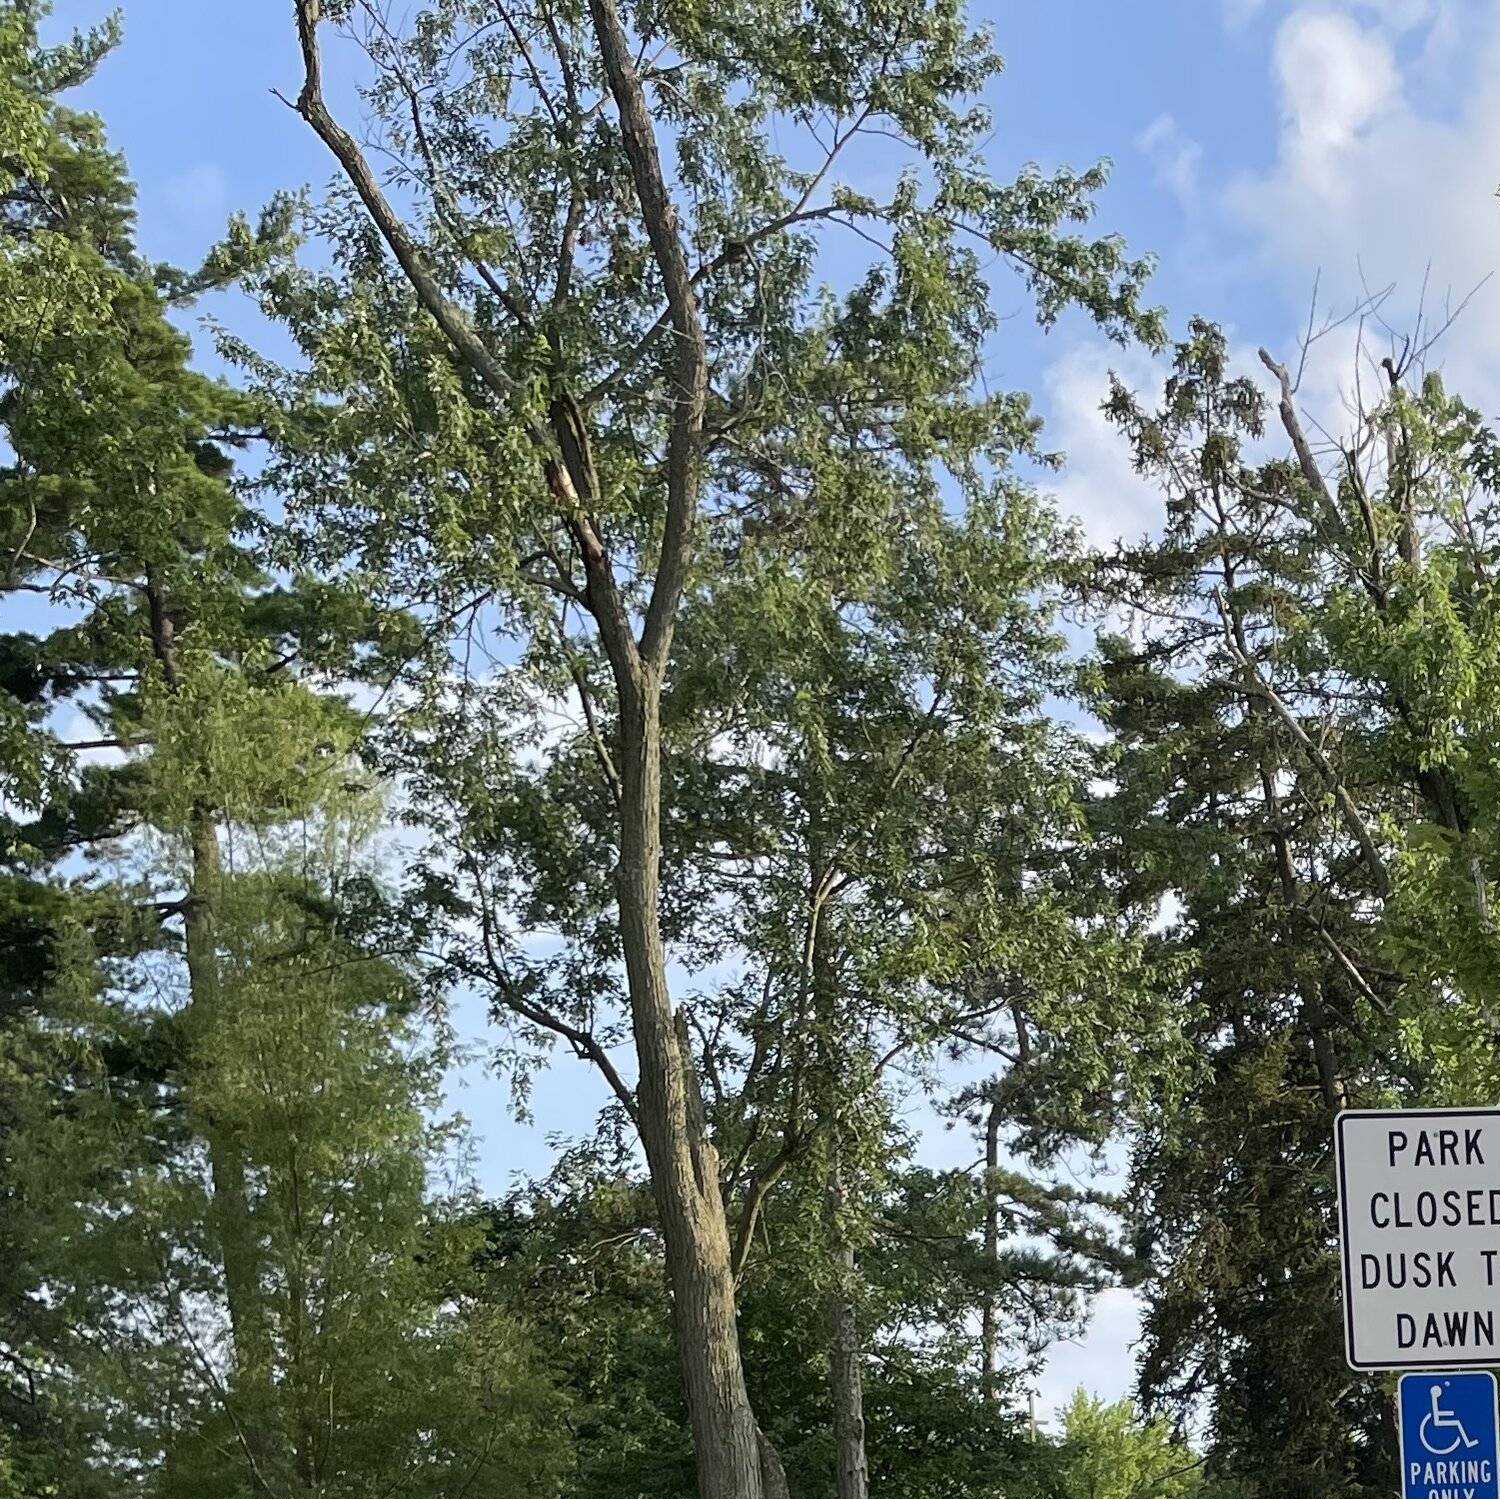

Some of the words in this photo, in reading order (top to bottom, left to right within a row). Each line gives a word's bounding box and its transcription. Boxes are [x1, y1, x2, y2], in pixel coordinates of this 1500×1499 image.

[1388, 1129, 1486, 1167] PARK
[1361, 1251, 1457, 1290] DUSK
[1396, 1311, 1495, 1349] DAWN
[1410, 1460, 1492, 1486] PARKING
